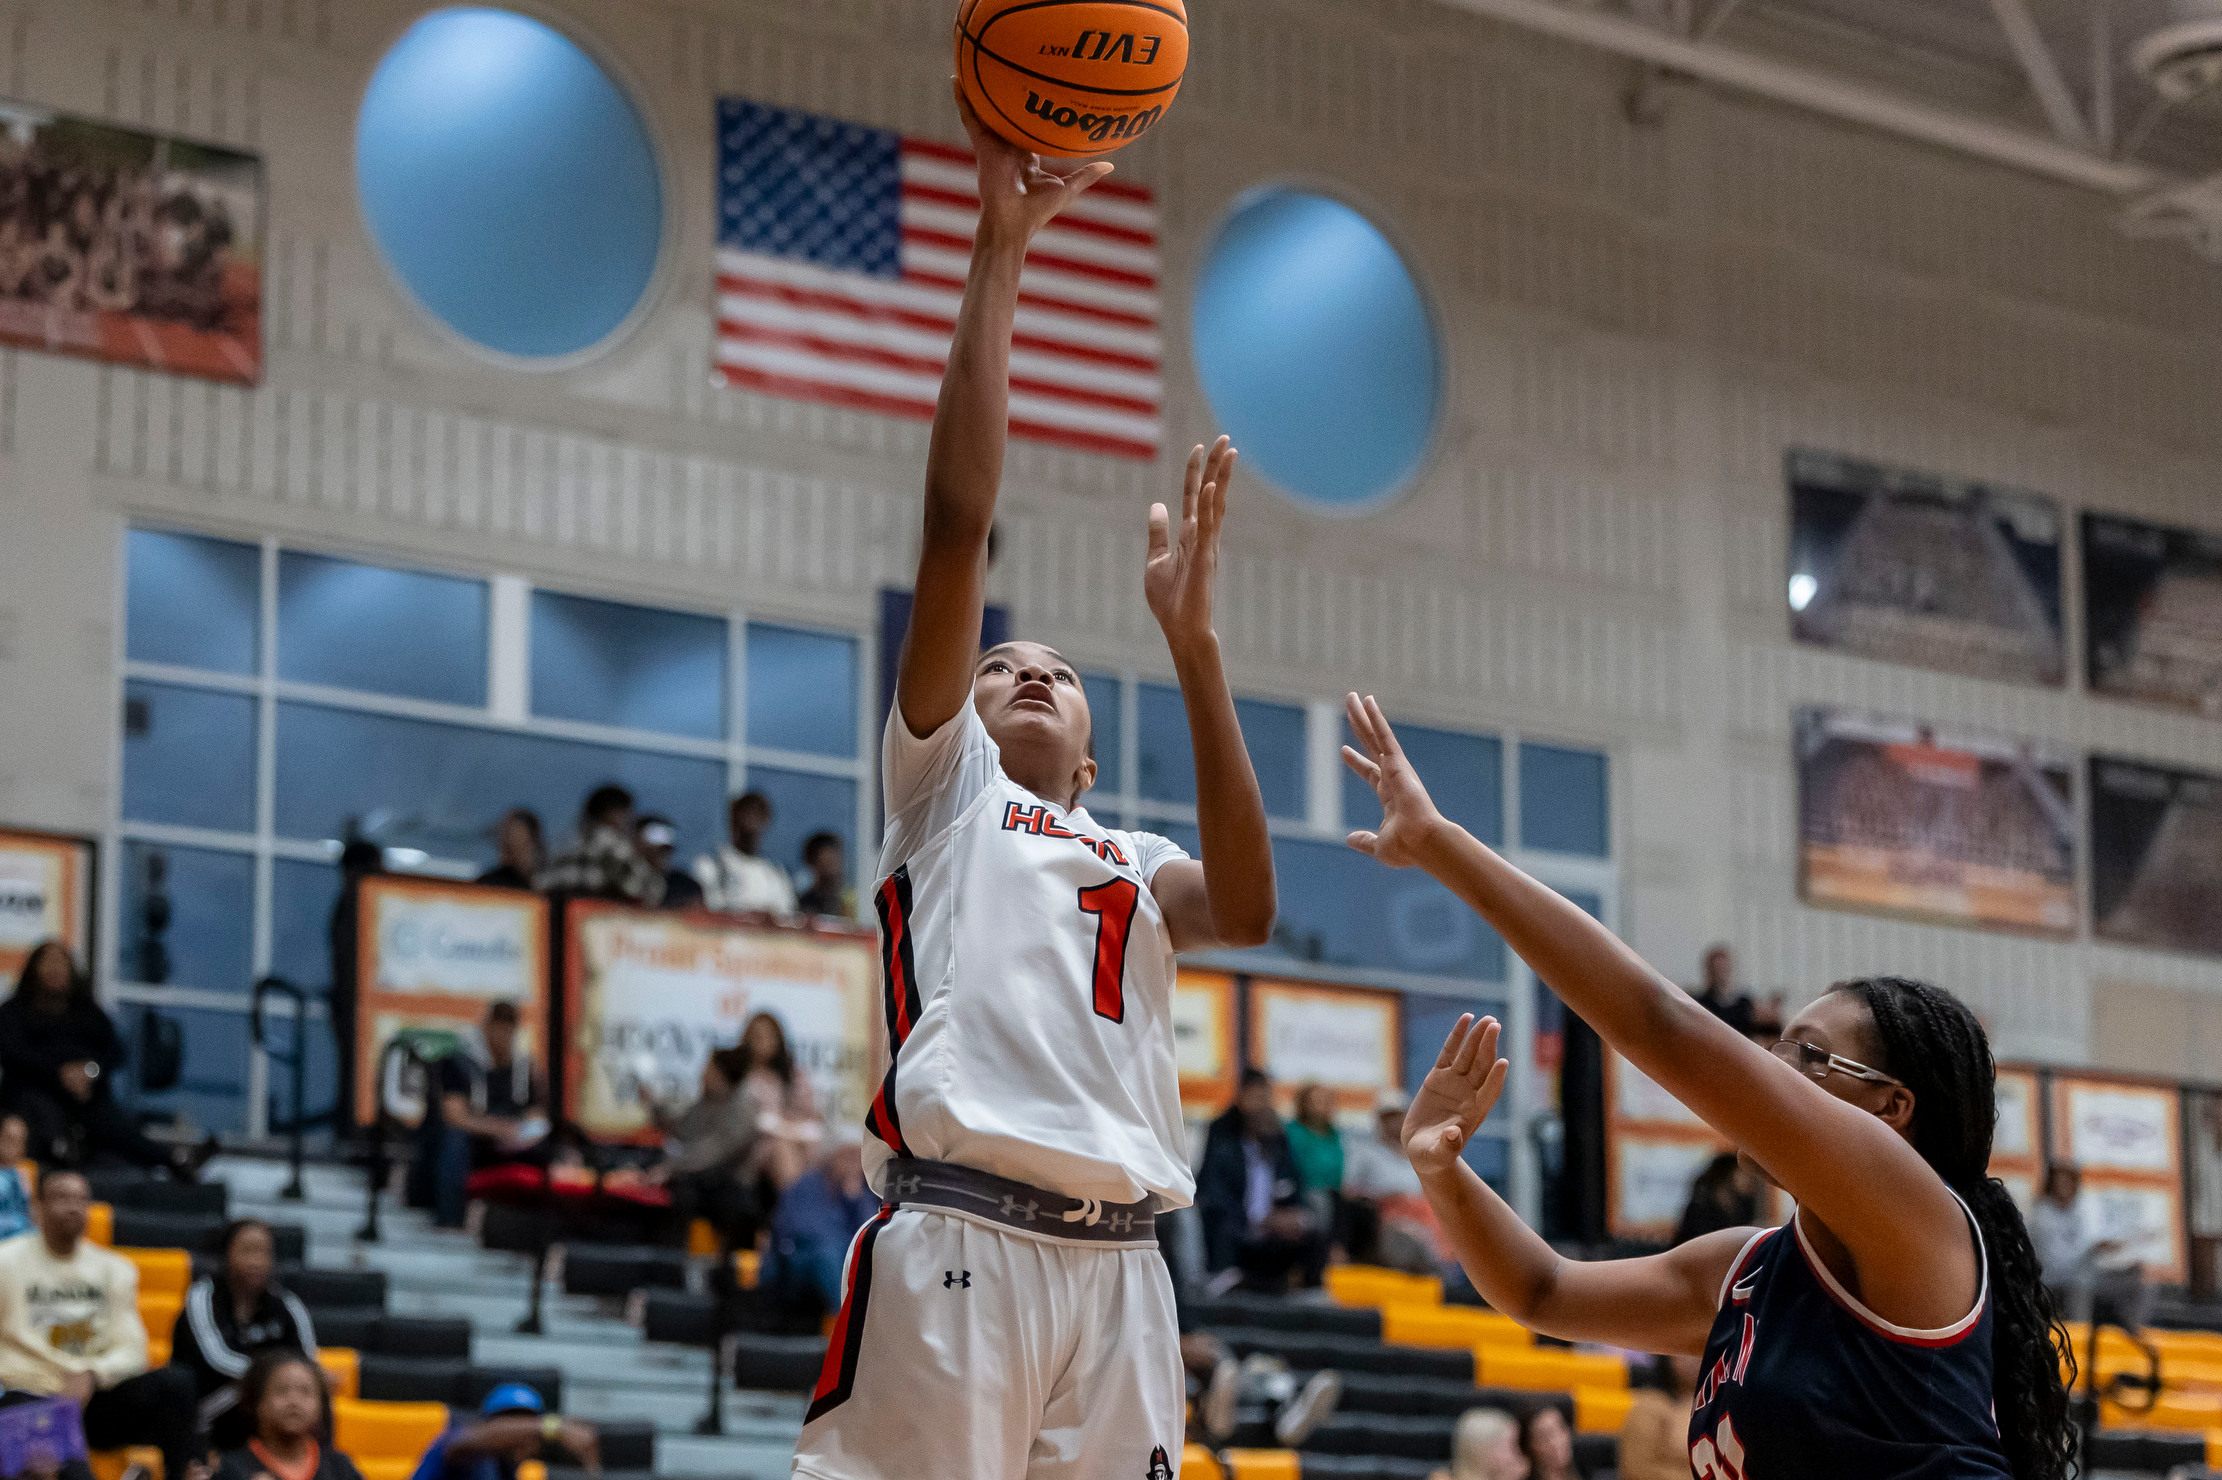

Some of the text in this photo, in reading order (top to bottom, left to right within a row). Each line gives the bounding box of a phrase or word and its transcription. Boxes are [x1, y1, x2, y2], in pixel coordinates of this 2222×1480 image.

[1038, 30, 1161, 65] EVO NXT
[1024, 90, 1163, 142] Wilson
[1078, 875, 1139, 1024] 1
